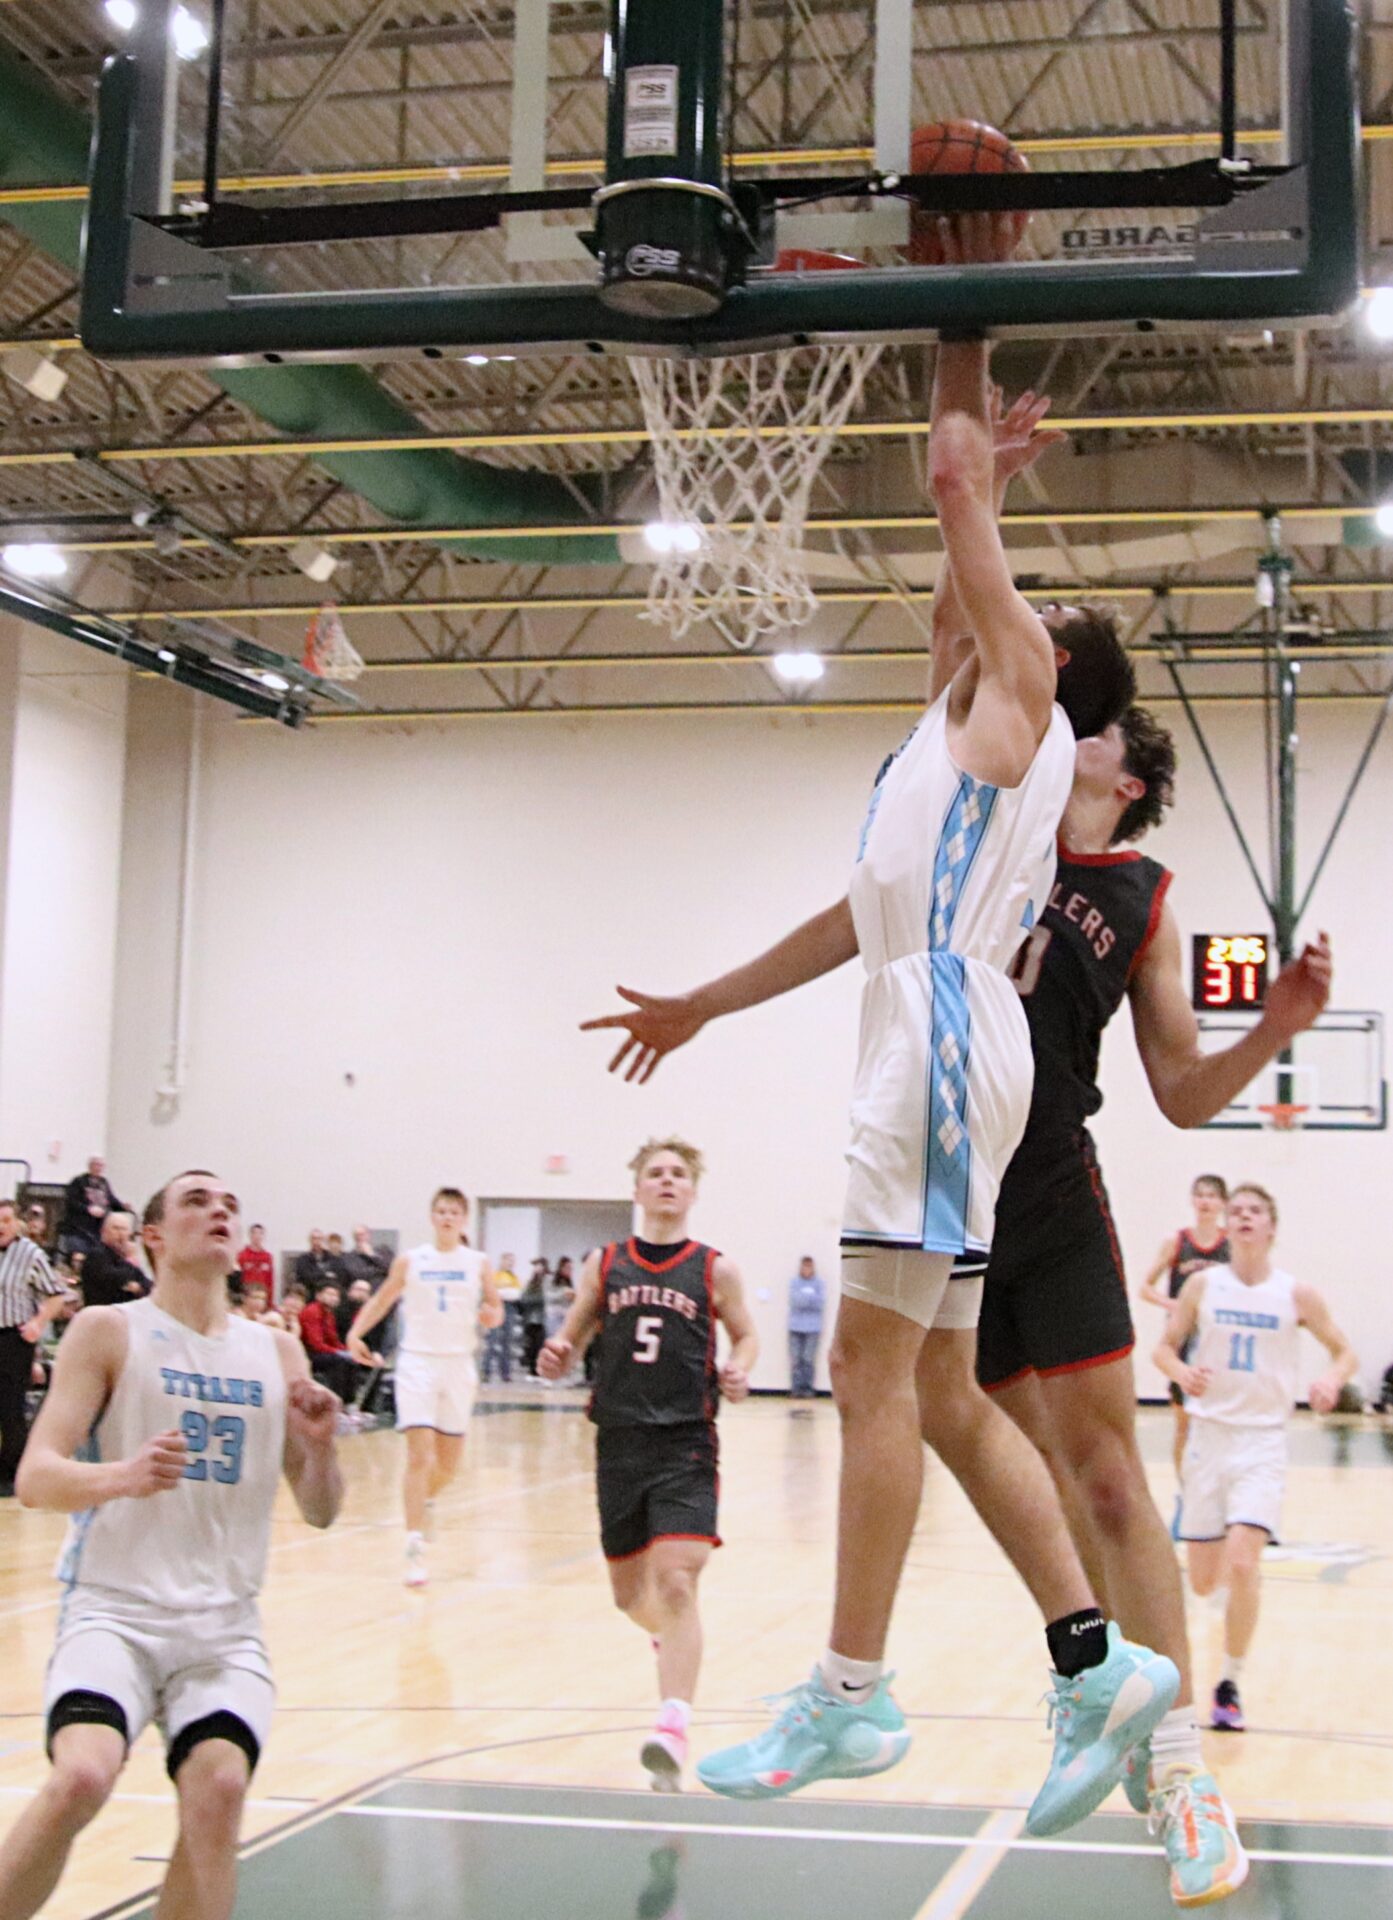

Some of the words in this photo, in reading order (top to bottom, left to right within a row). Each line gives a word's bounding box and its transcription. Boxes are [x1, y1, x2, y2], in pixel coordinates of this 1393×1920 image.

[1047, 883, 1117, 960] LERS
[1204, 963, 1258, 1004] 31
[608, 1284, 699, 1320] RATTLERS
[632, 1316, 663, 1363] 5
[1228, 1333, 1256, 1373] 11
[160, 1367, 263, 1408] TITANS
